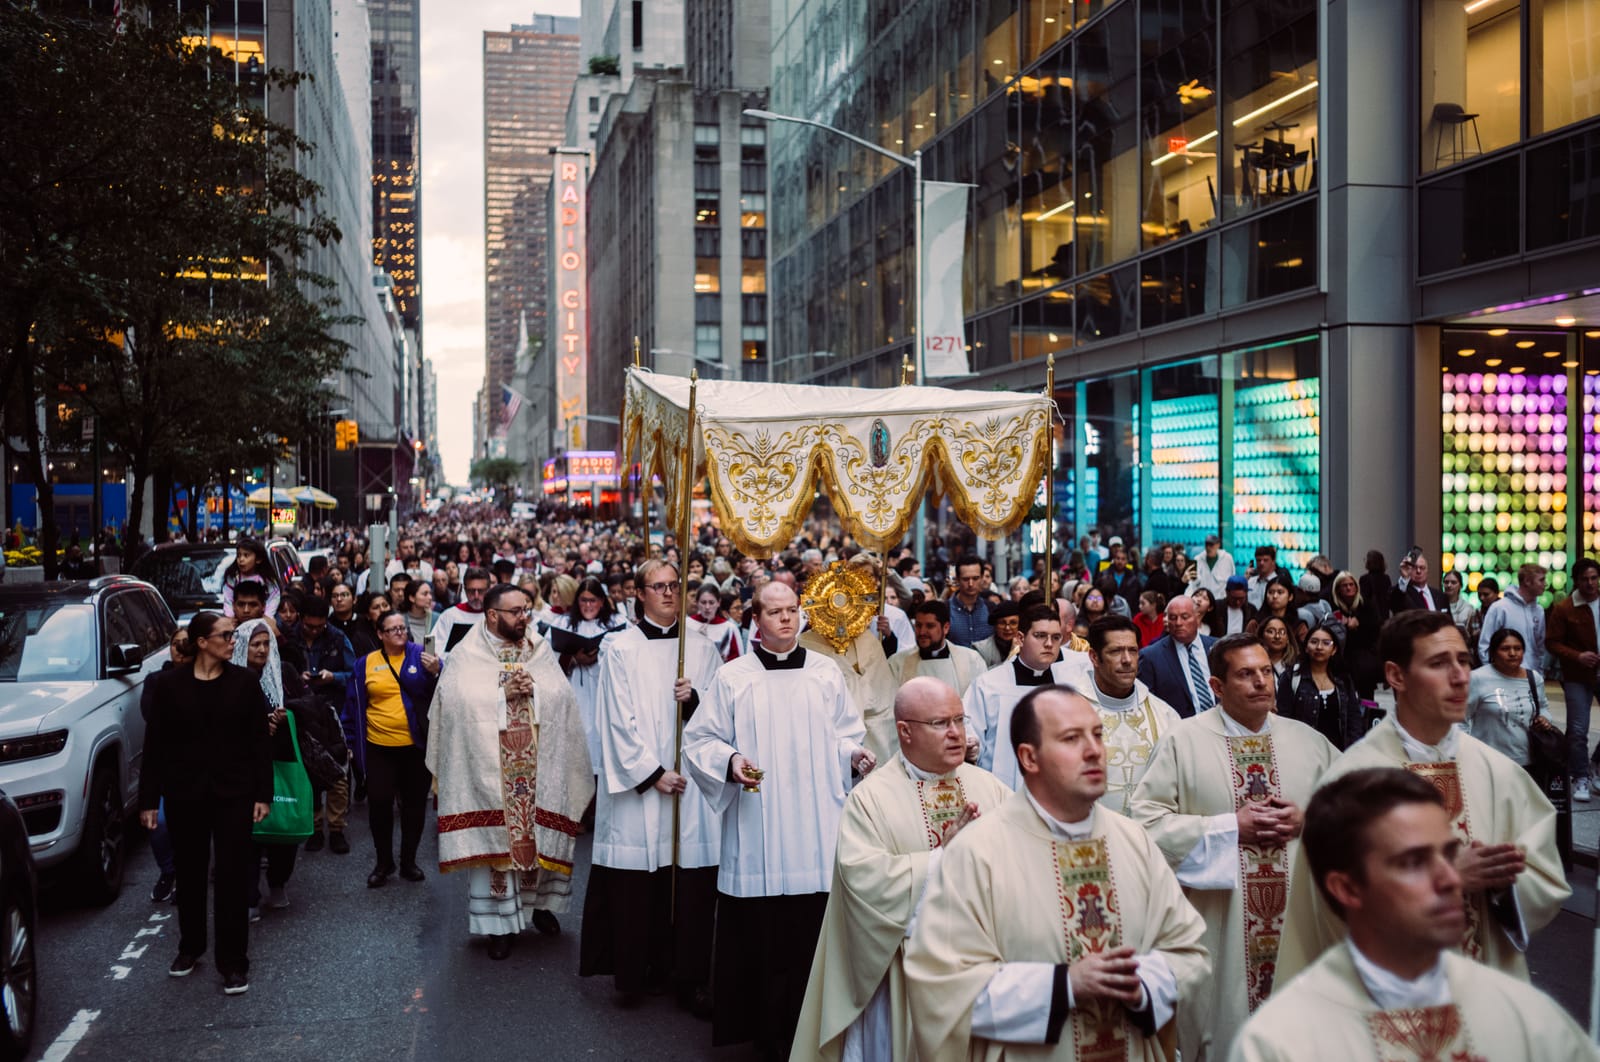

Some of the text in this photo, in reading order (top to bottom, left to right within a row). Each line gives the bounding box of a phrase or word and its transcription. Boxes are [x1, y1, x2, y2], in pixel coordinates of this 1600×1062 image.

[562, 162, 581, 271] RADIO
[562, 290, 581, 374] CITY
[926, 336, 962, 353] 1271
[572, 457, 613, 466] RADIO
